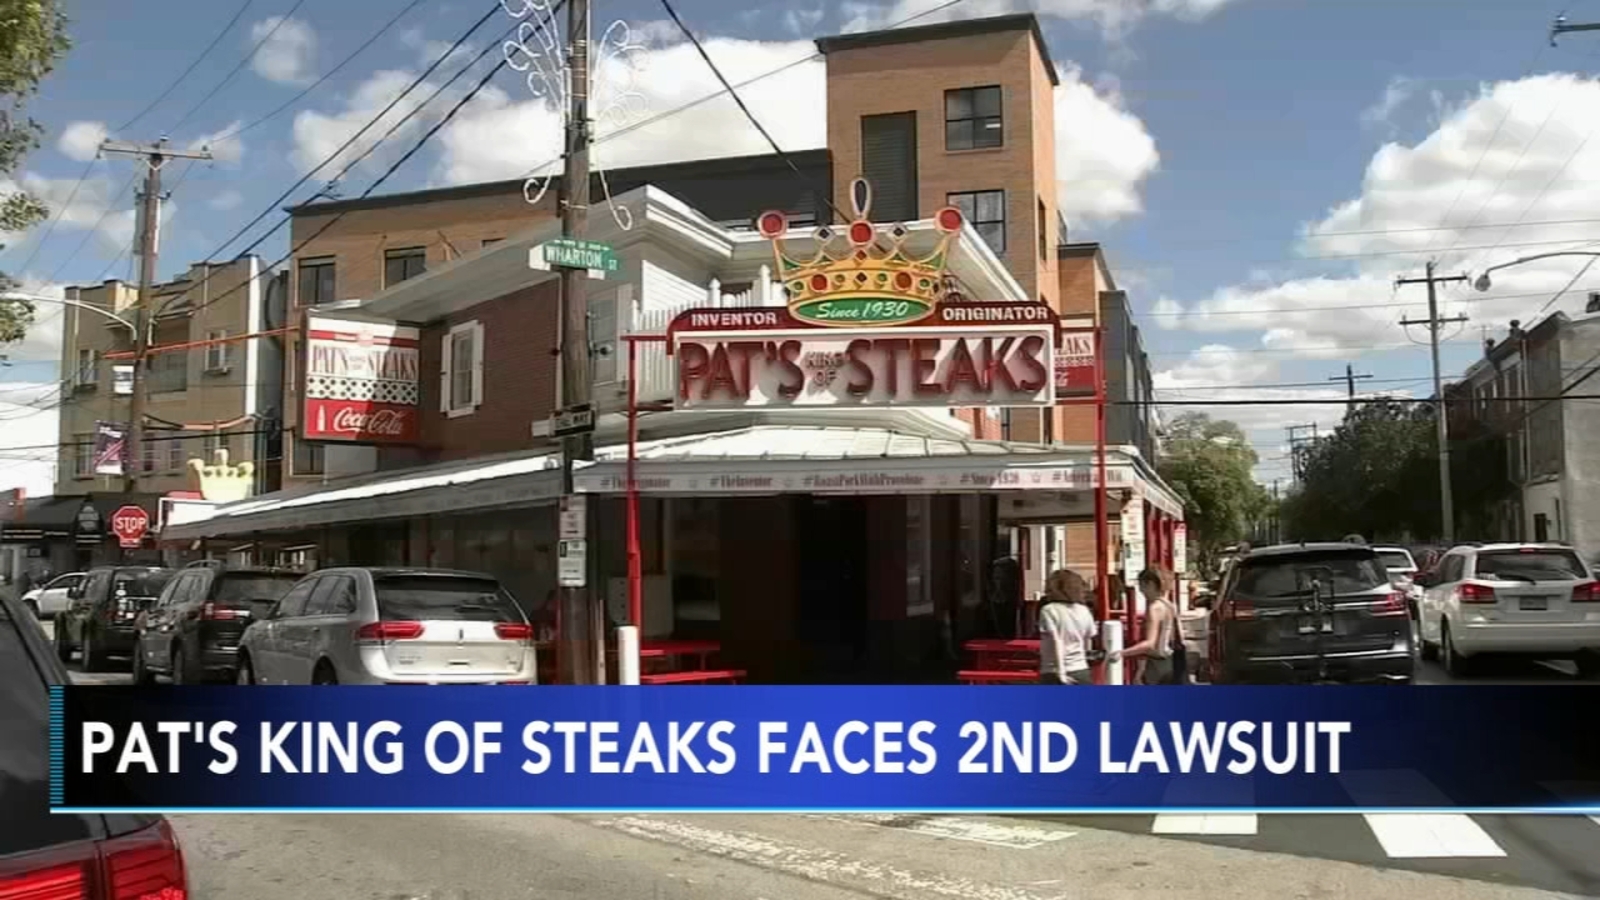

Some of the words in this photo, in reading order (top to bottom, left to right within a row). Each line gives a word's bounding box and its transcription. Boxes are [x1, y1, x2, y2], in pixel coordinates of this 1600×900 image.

[546, 244, 602, 269] WHARTON
[816, 302, 859, 318] Since
[863, 301, 909, 317] 1930
[943, 306, 1048, 320] ORIGINATOR
[691, 312, 777, 326] INVENTOR
[679, 339, 804, 400] PAT'S
[814, 370, 836, 386] OF
[846, 335, 1047, 393] STEAKS
[115, 516, 146, 530] STOP
